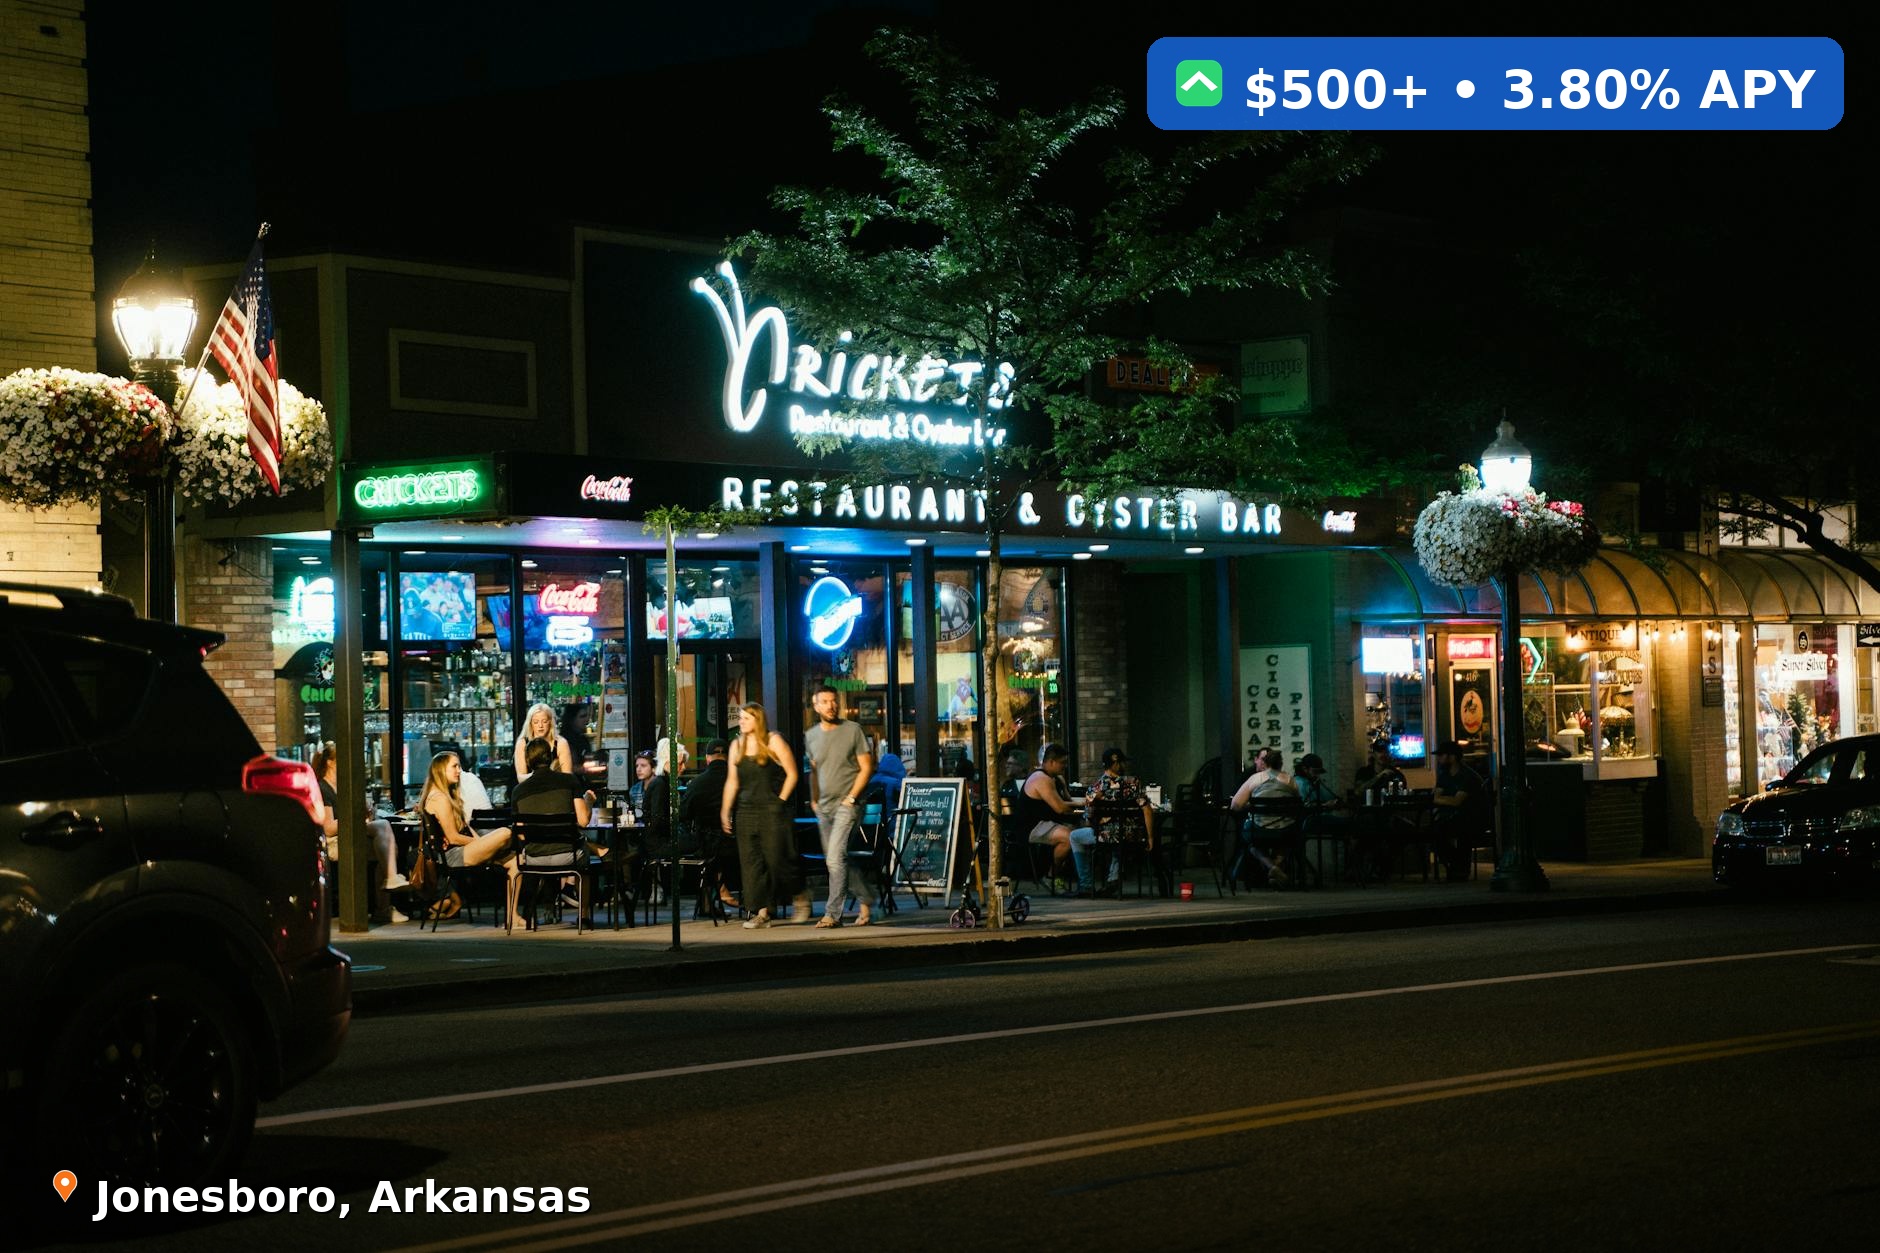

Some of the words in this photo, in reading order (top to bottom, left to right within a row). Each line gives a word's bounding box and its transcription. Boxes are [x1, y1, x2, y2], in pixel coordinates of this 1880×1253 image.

[893, 412, 909, 439] &
[722, 477, 988, 523] RESTAURANT
[1019, 492, 1041, 524] &
[1220, 501, 1282, 534] BAR
[1573, 629, 1626, 643] NTIQUE
[1860, 625, 1880, 635] Silve
